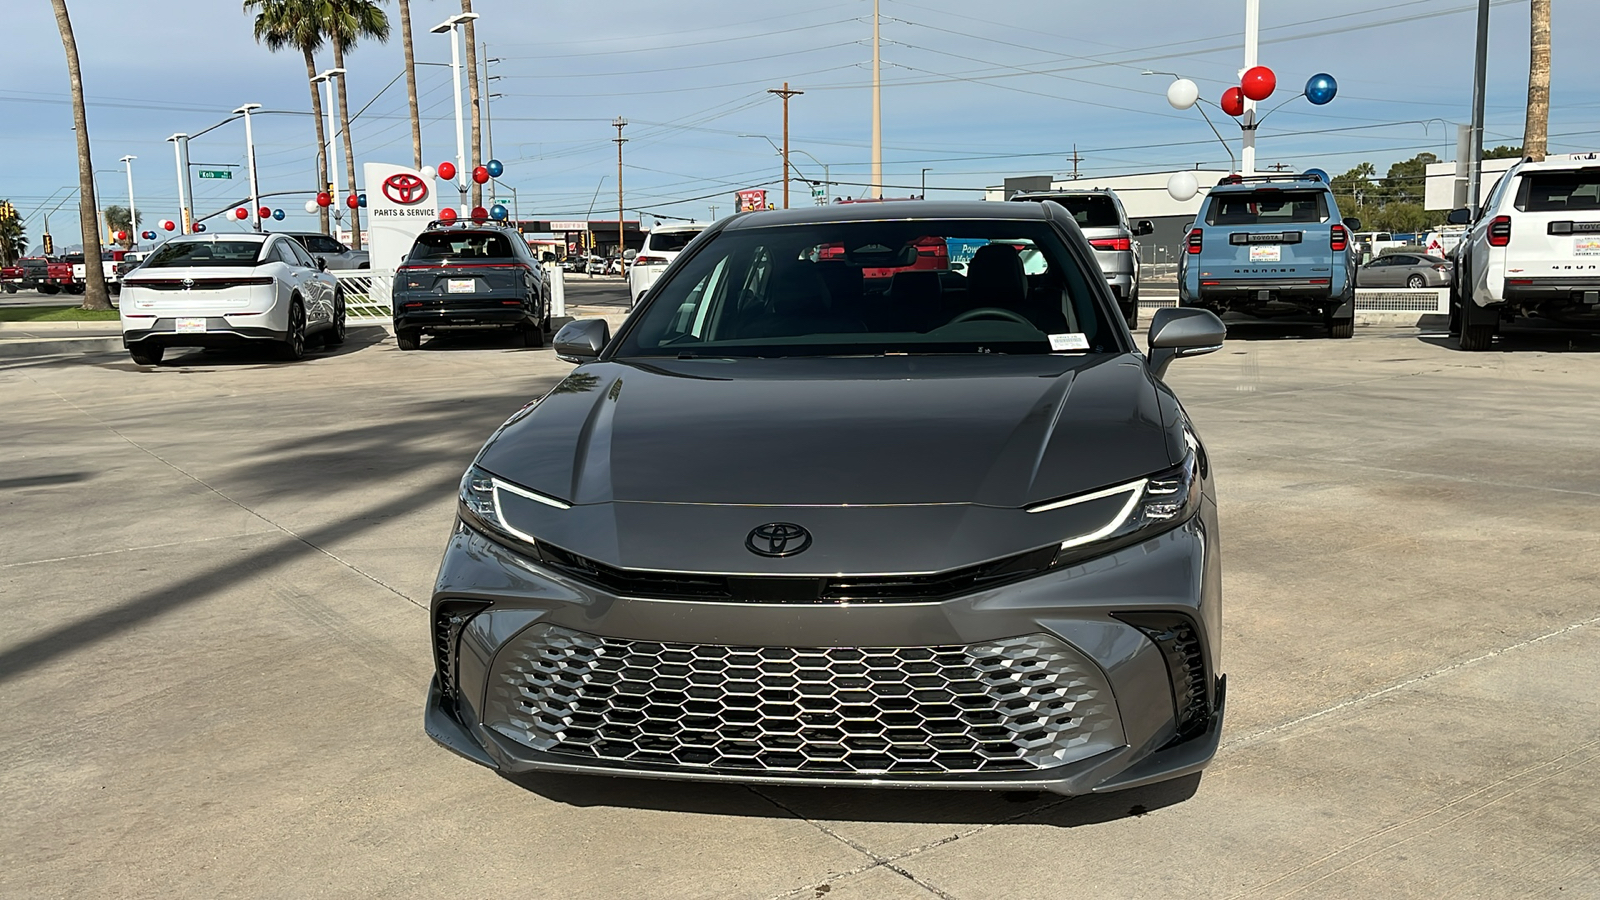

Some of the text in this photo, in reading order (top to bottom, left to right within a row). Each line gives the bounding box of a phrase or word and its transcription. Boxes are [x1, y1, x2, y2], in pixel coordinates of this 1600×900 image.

[374, 208, 435, 217] PARTS & SERVICE
